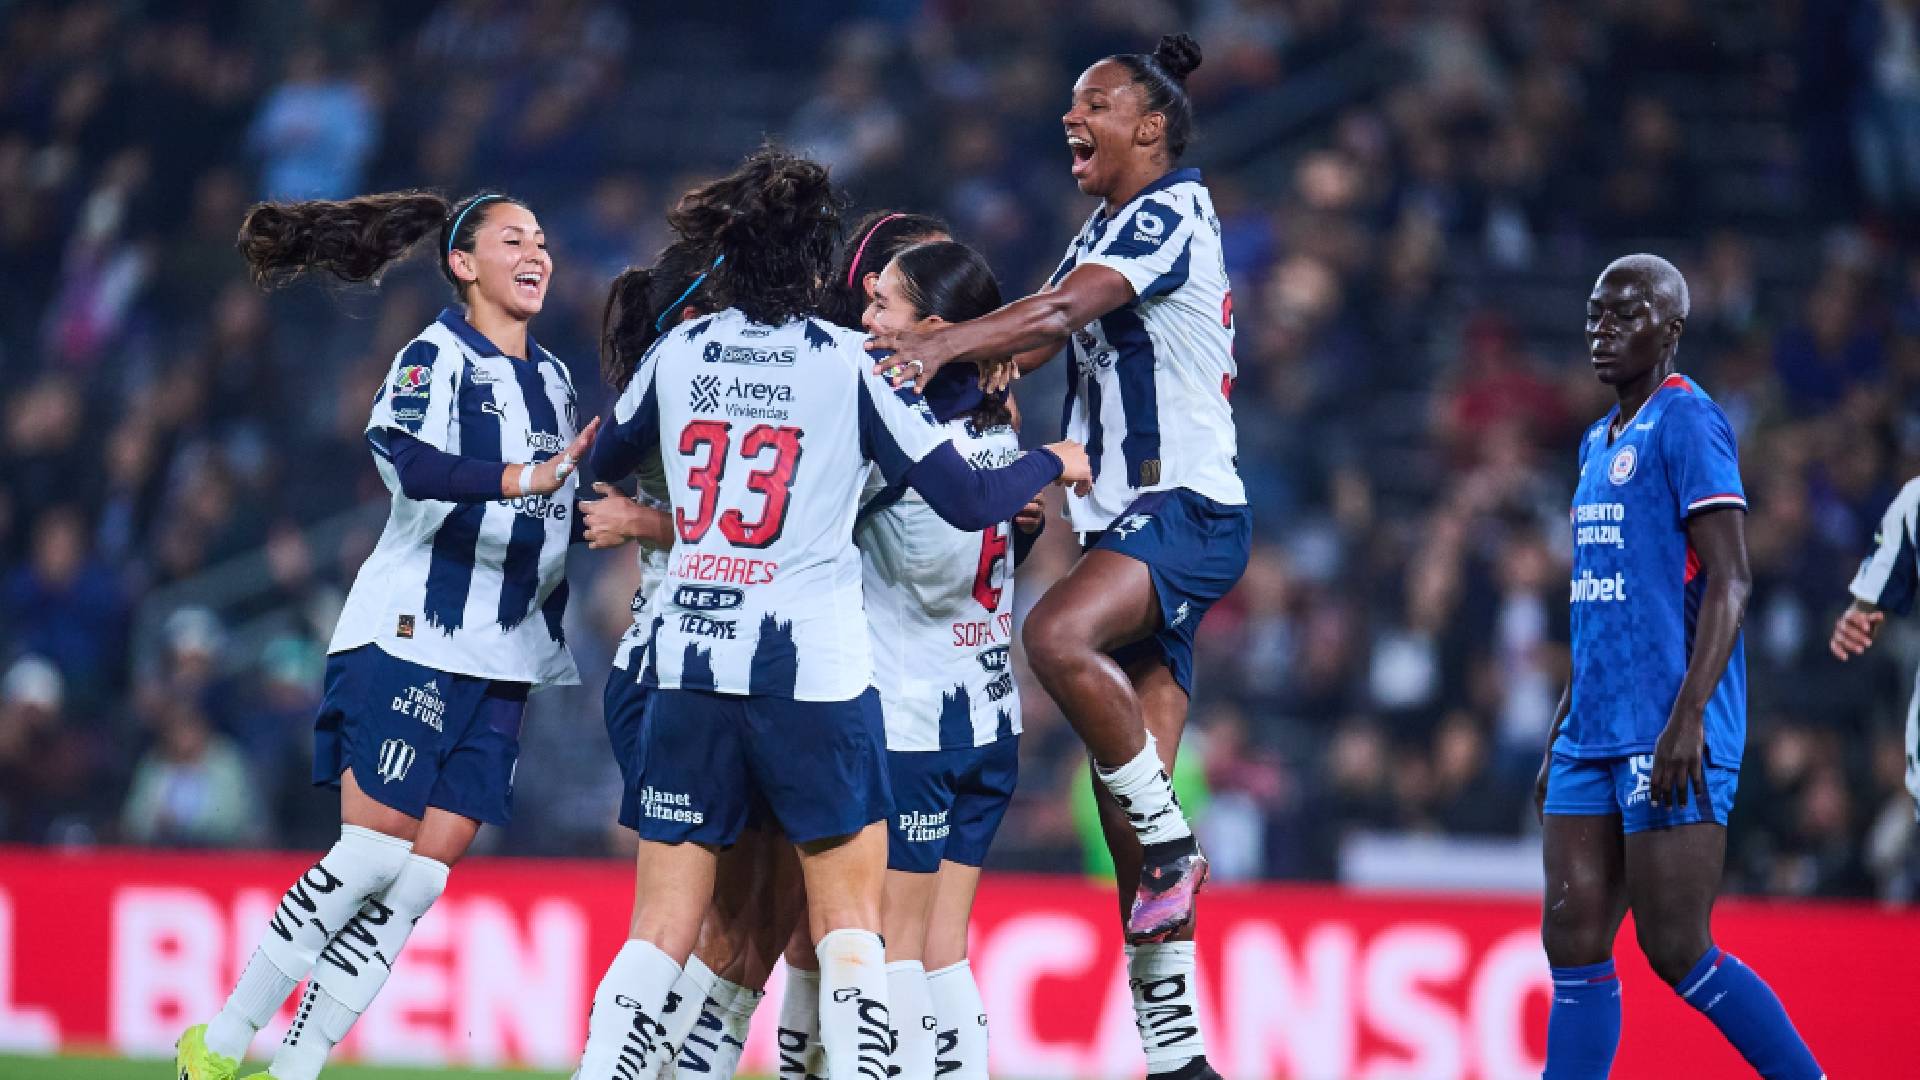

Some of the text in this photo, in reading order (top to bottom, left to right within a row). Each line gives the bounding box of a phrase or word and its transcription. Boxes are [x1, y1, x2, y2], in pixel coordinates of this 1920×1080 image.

[726, 377, 792, 404] Areya
[726, 403, 789, 420] Viviendas
[676, 420, 804, 549] 33
[680, 613, 737, 639] TECATE
[392, 696, 412, 714] DE
